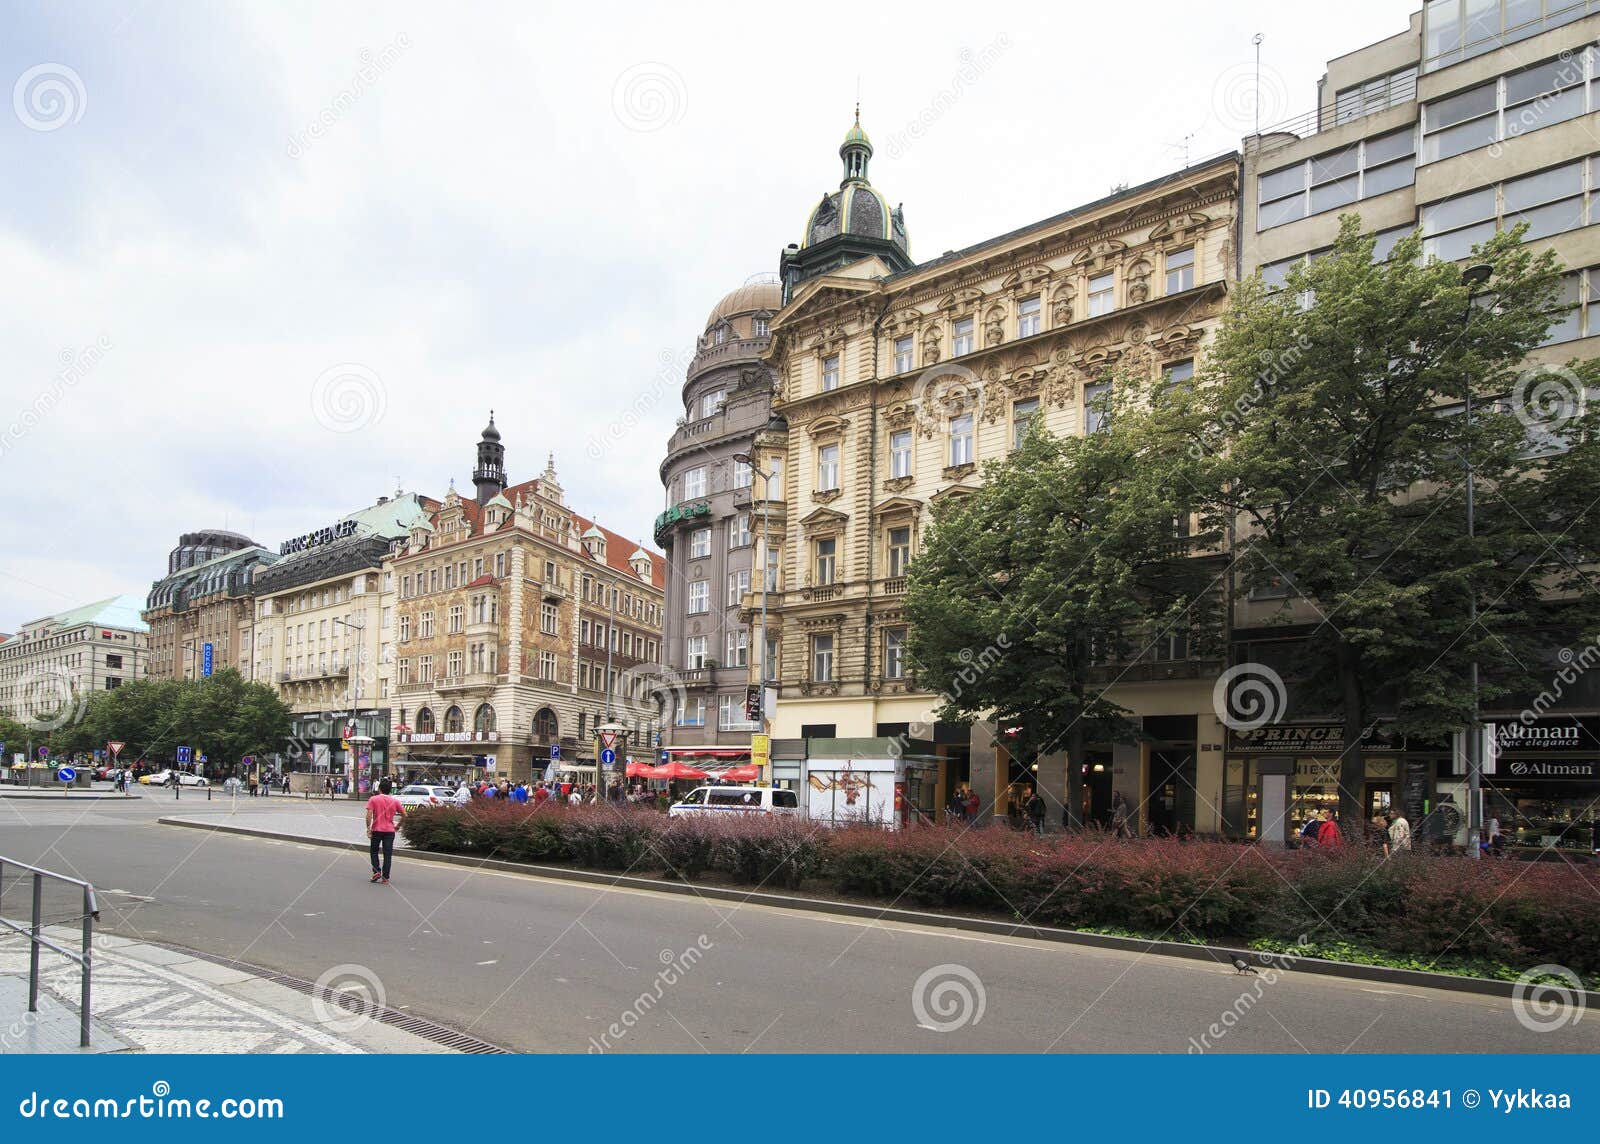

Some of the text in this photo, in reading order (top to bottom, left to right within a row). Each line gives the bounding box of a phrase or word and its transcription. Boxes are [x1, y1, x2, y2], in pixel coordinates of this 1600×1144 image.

[1495, 724, 1580, 739] Altman
[1525, 738, 1579, 747] elegance
[1528, 763, 1592, 774] Altman
